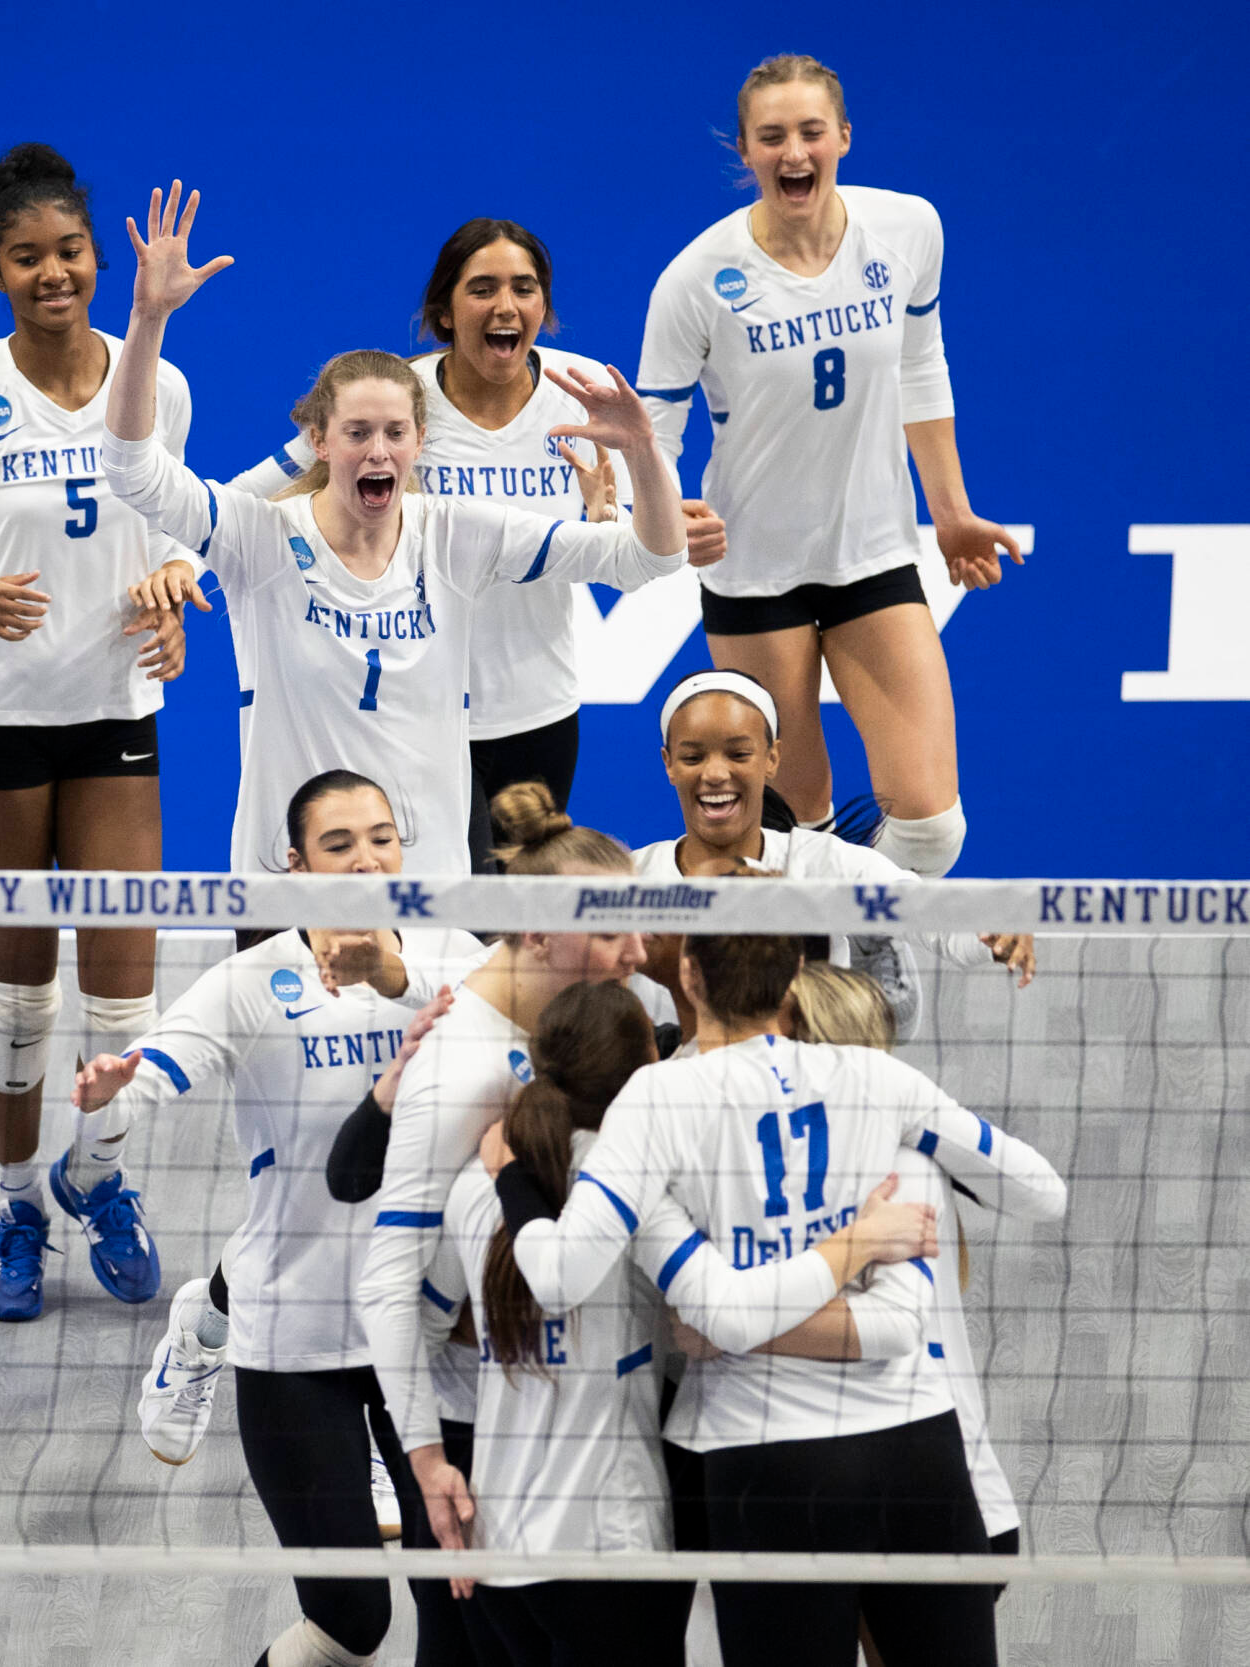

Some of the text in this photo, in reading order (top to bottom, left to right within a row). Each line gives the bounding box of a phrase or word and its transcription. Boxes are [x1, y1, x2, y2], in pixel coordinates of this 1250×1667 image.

[718, 280, 746, 293] NCAA
[864, 262, 890, 289] SEC
[746, 294, 893, 353] KENTUCKY
[813, 347, 845, 411] 8
[2, 447, 102, 482] KENTU
[414, 465, 575, 496] KENTUCKY
[65, 478, 98, 539] 5
[359, 648, 382, 711] 1
[47, 878, 248, 915] WILDCATS
[275, 983, 301, 994] NCAA
[758, 1101, 829, 1218] 17
